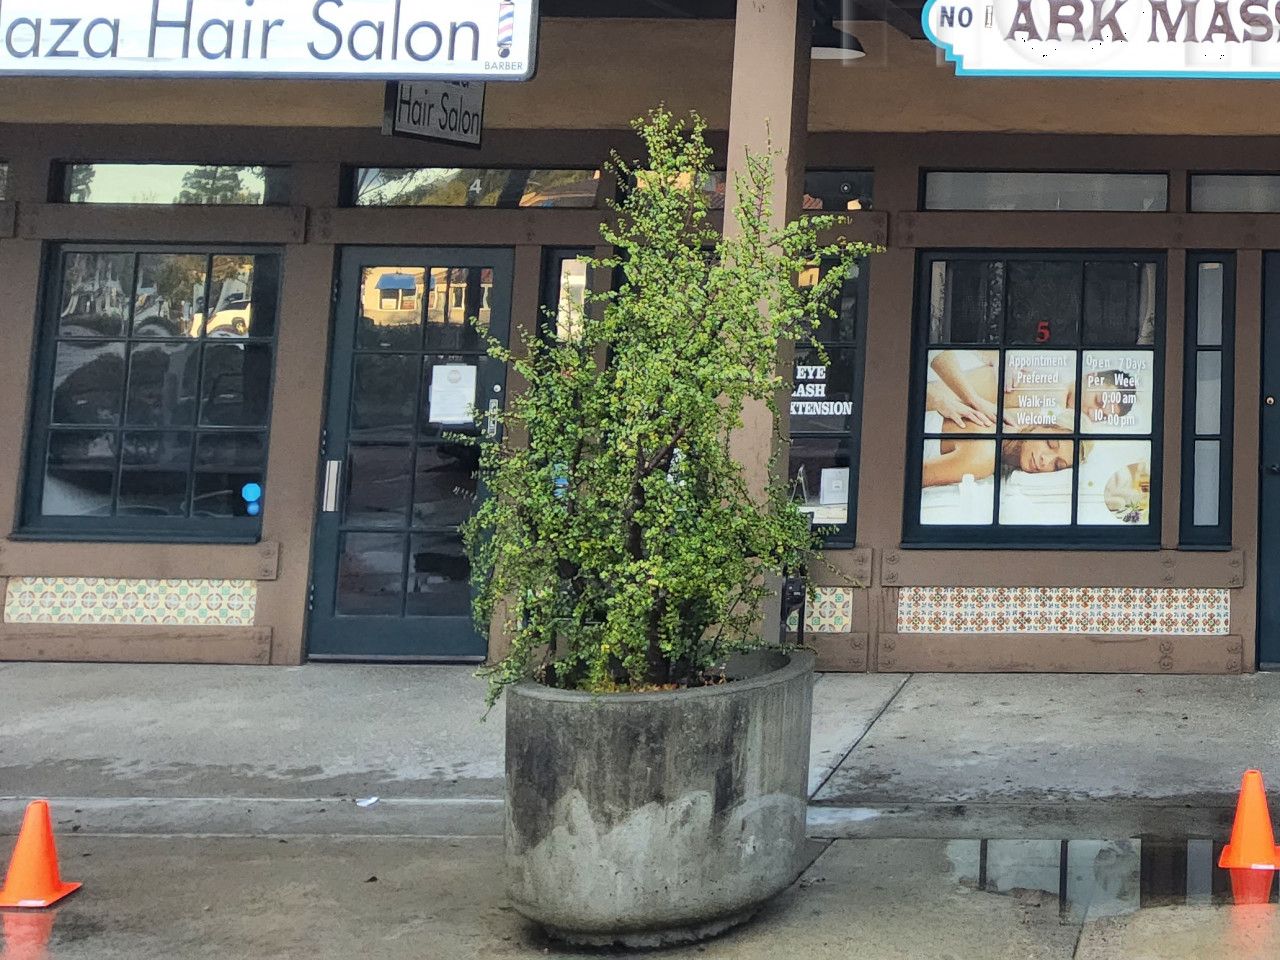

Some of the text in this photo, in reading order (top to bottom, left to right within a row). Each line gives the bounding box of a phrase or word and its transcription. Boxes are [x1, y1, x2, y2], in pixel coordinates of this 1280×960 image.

[939, 6, 974, 29] NO
[484, 61, 523, 71] BARBER
[398, 84, 480, 135] Hair Salon
[469, 179, 482, 194] 4
[1036, 321, 1050, 342] 5
[1009, 354, 1068, 369] Appointment
[1086, 355, 1110, 370] Open
[1126, 358, 1146, 373] Days
[796, 365, 826, 379] EYE
[1017, 370, 1060, 384] Preferred
[791, 384, 826, 397] ASH
[1122, 394, 1137, 404] am
[1017, 412, 1057, 425] Welcome
[1121, 414, 1135, 427] pm
